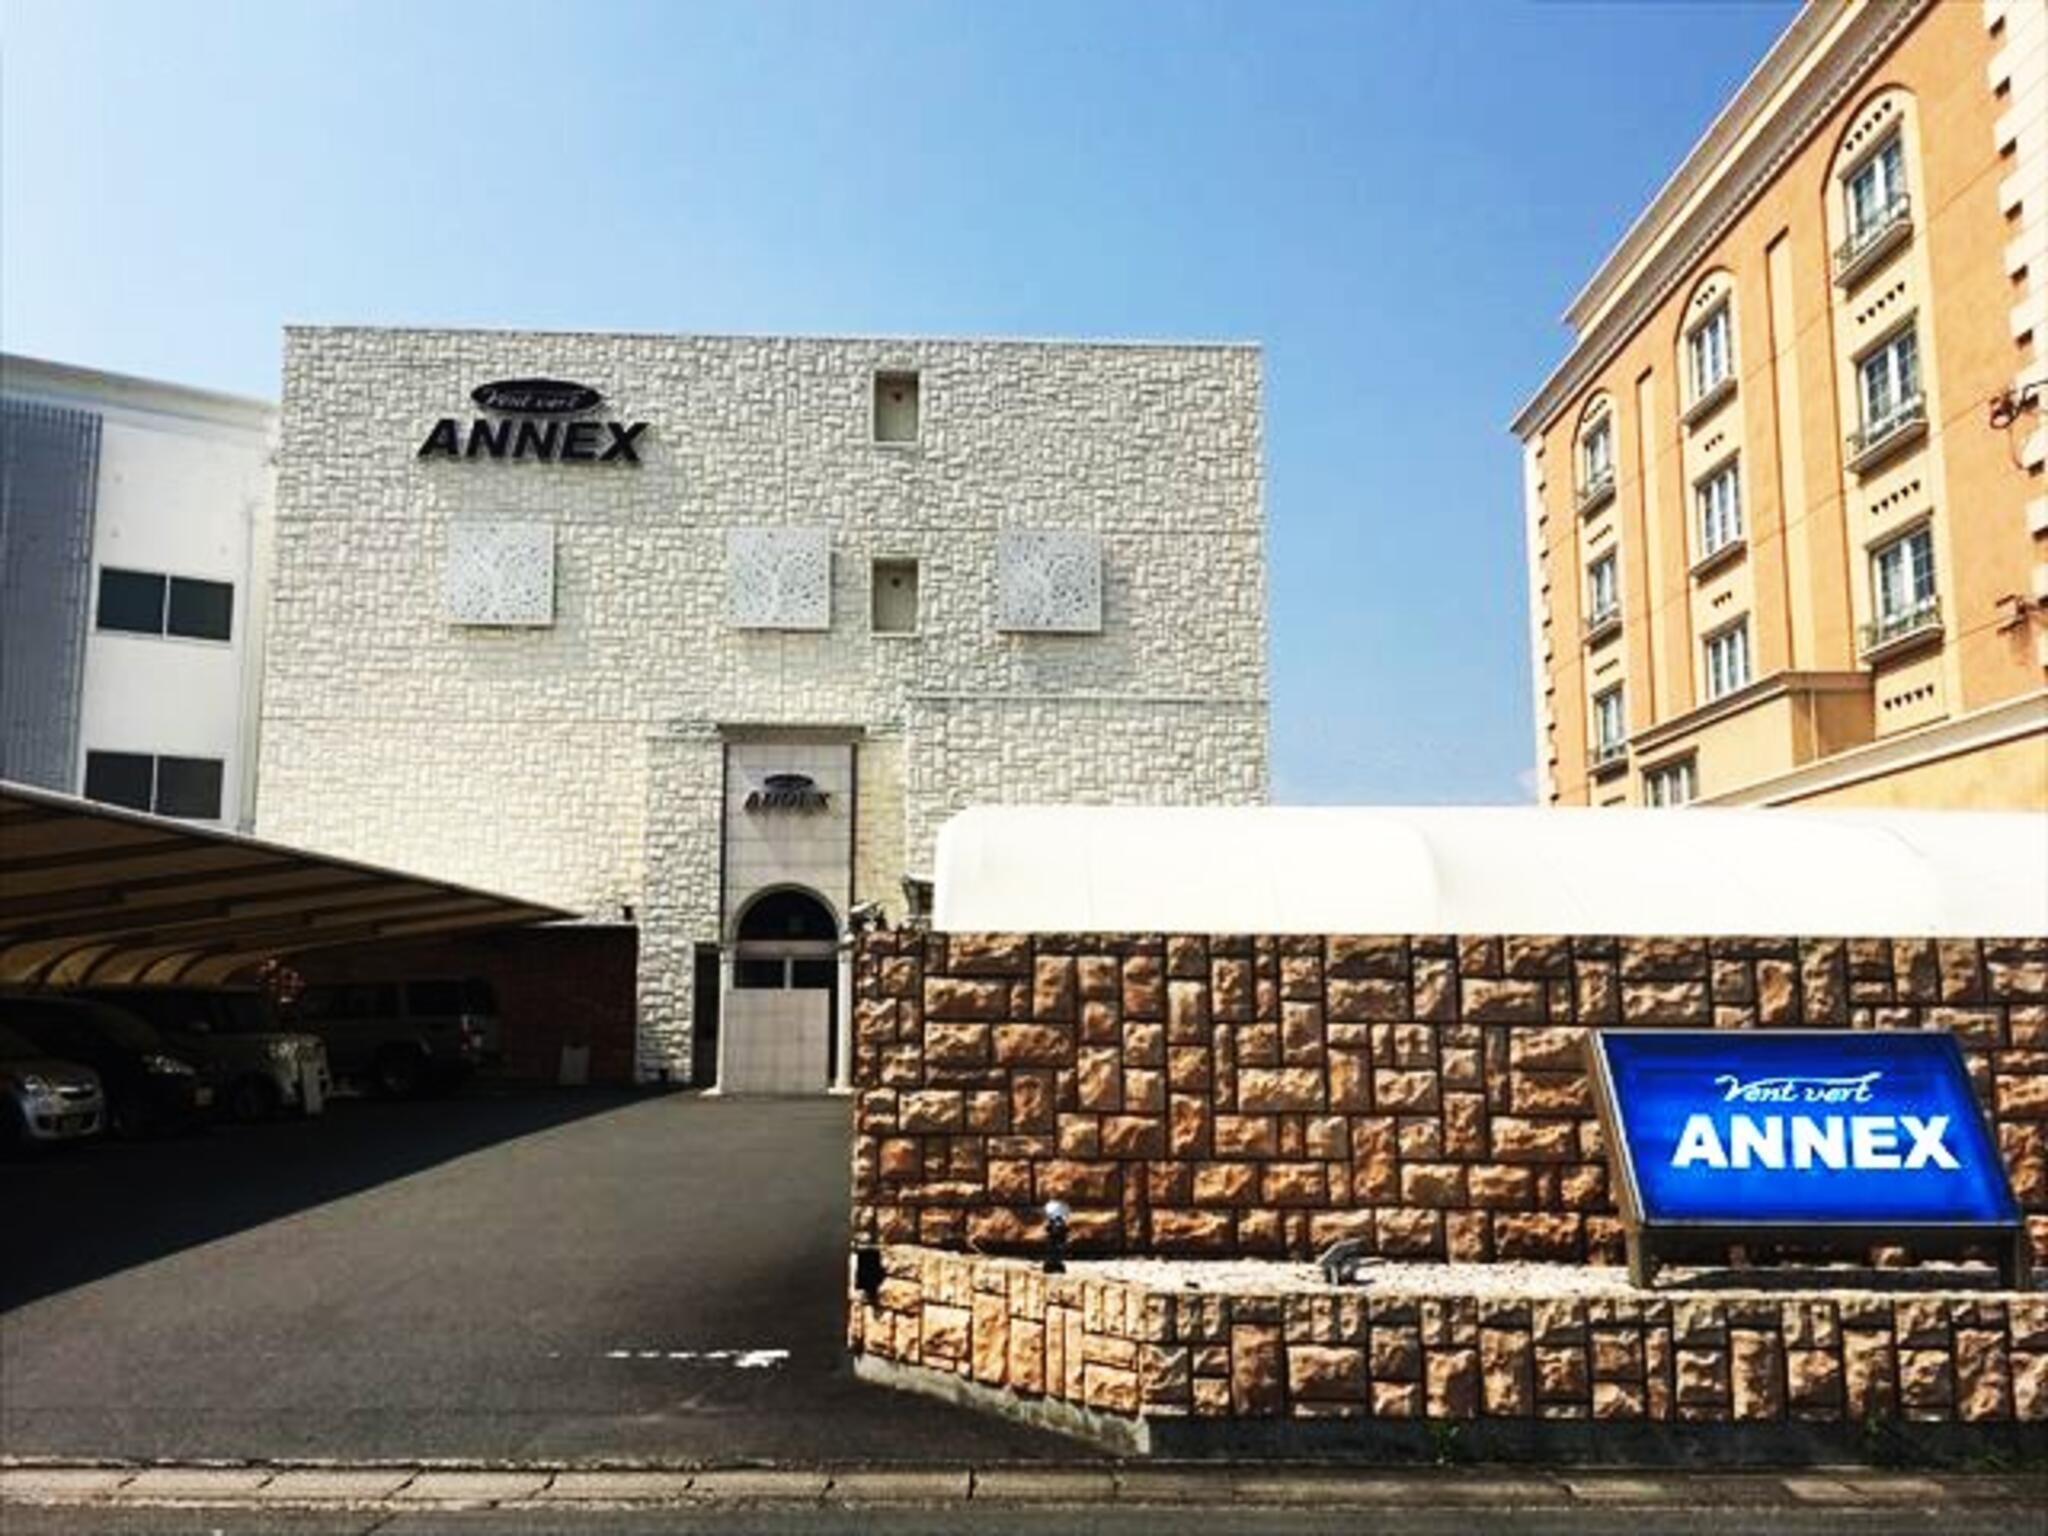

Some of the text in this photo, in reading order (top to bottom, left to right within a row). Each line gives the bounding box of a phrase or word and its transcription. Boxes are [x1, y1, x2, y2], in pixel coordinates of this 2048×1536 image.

[418, 418, 650, 462] ANNEX
[1714, 1071, 1883, 1103] Vent vert
[1670, 1113, 1962, 1170] ANNEX
